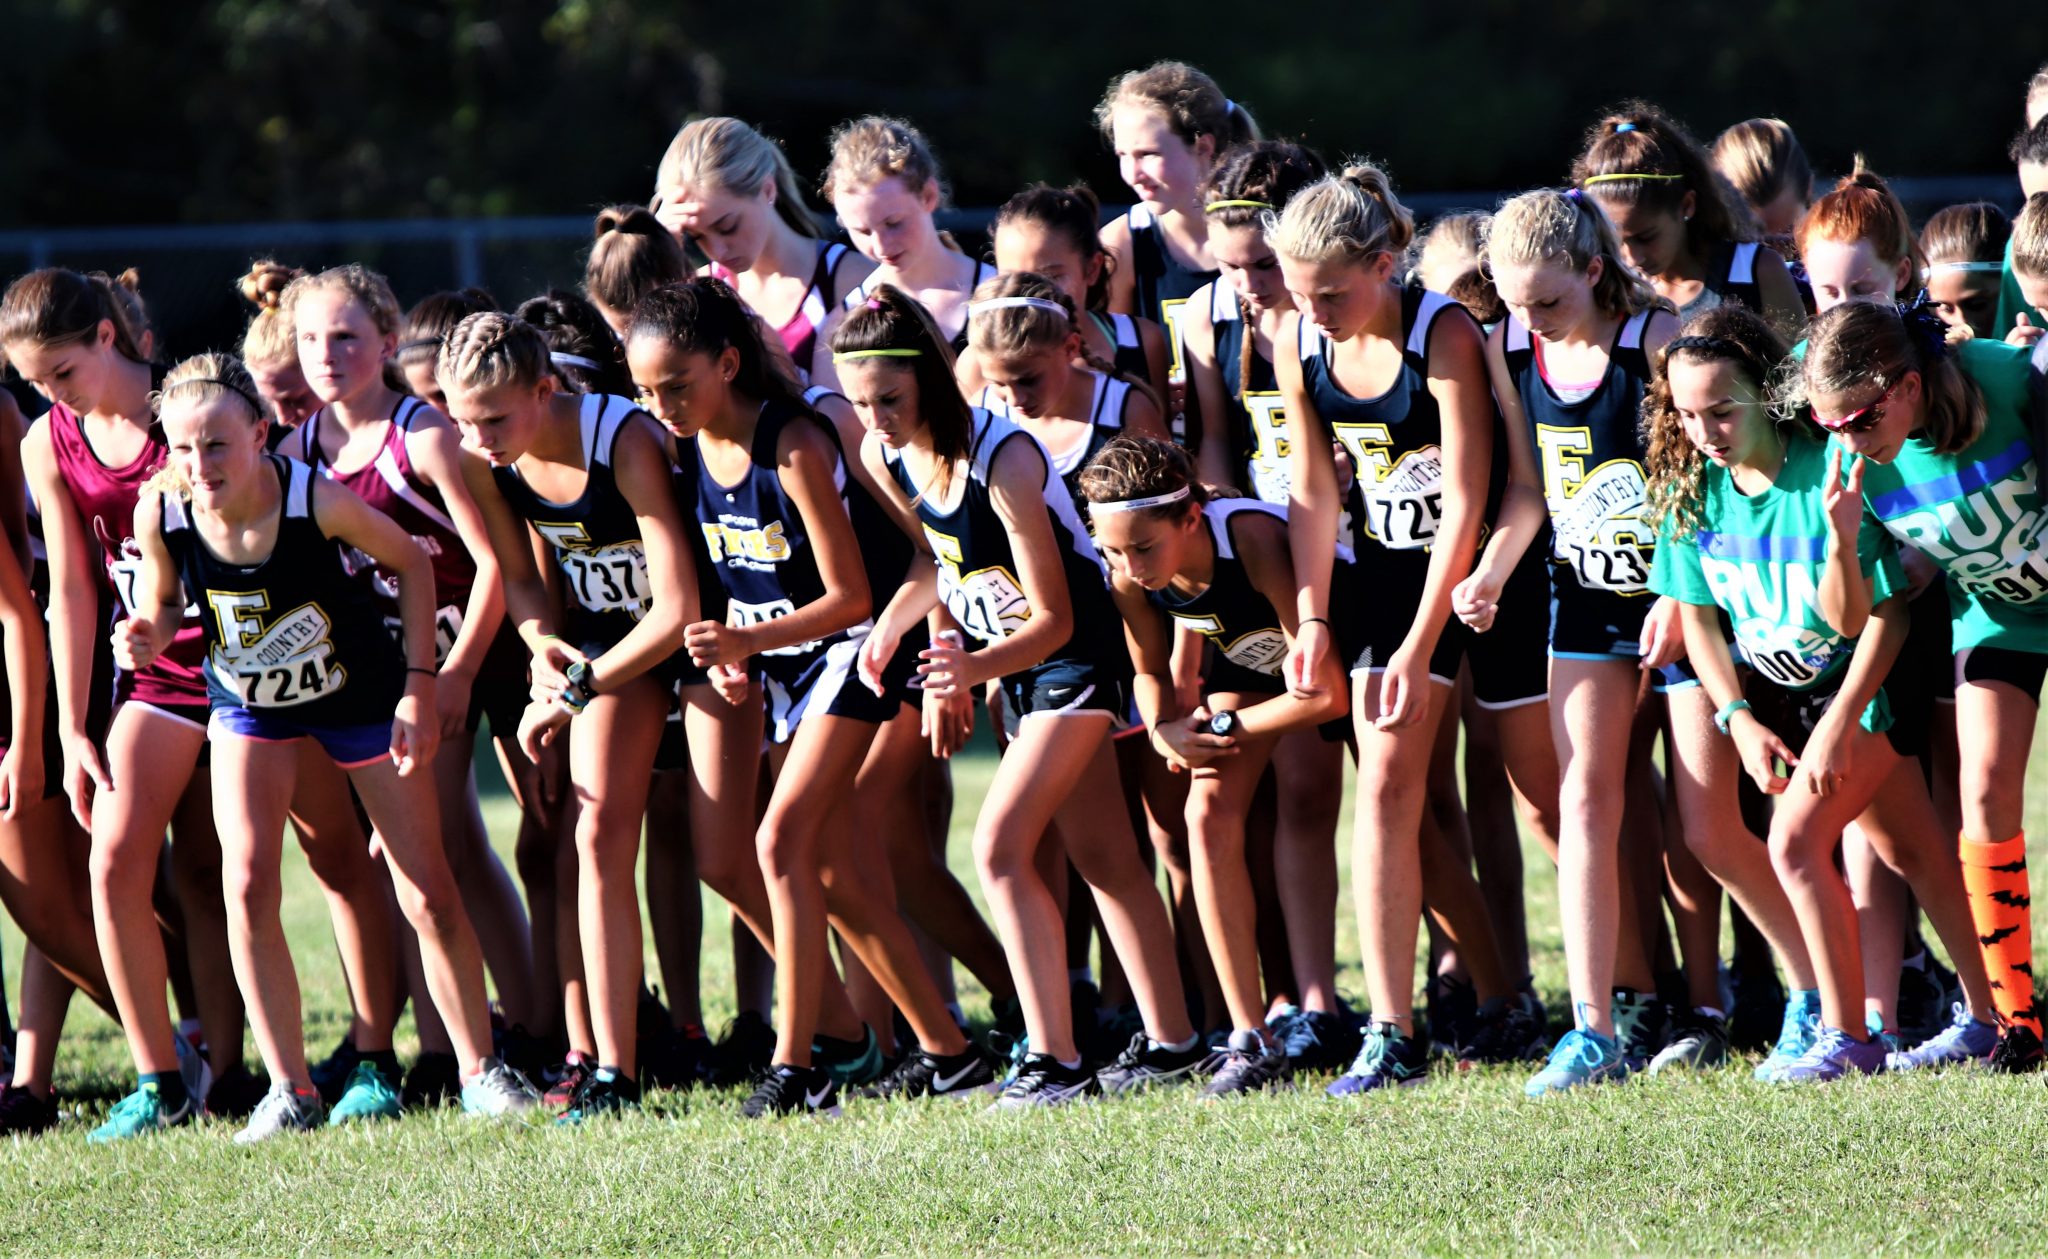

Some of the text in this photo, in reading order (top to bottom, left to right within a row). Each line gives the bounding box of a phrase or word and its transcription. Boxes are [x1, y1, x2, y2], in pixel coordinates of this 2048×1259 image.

[1332, 422, 1393, 483] E
[1537, 423, 1592, 500] E
[1376, 493, 1442, 541] 725
[572, 559, 638, 602] 737
[1570, 543, 1648, 585] 723
[1700, 556, 1827, 627] RUN
[206, 588, 270, 660] E
[257, 614, 318, 666] COUNTRY
[238, 659, 324, 702] 724
